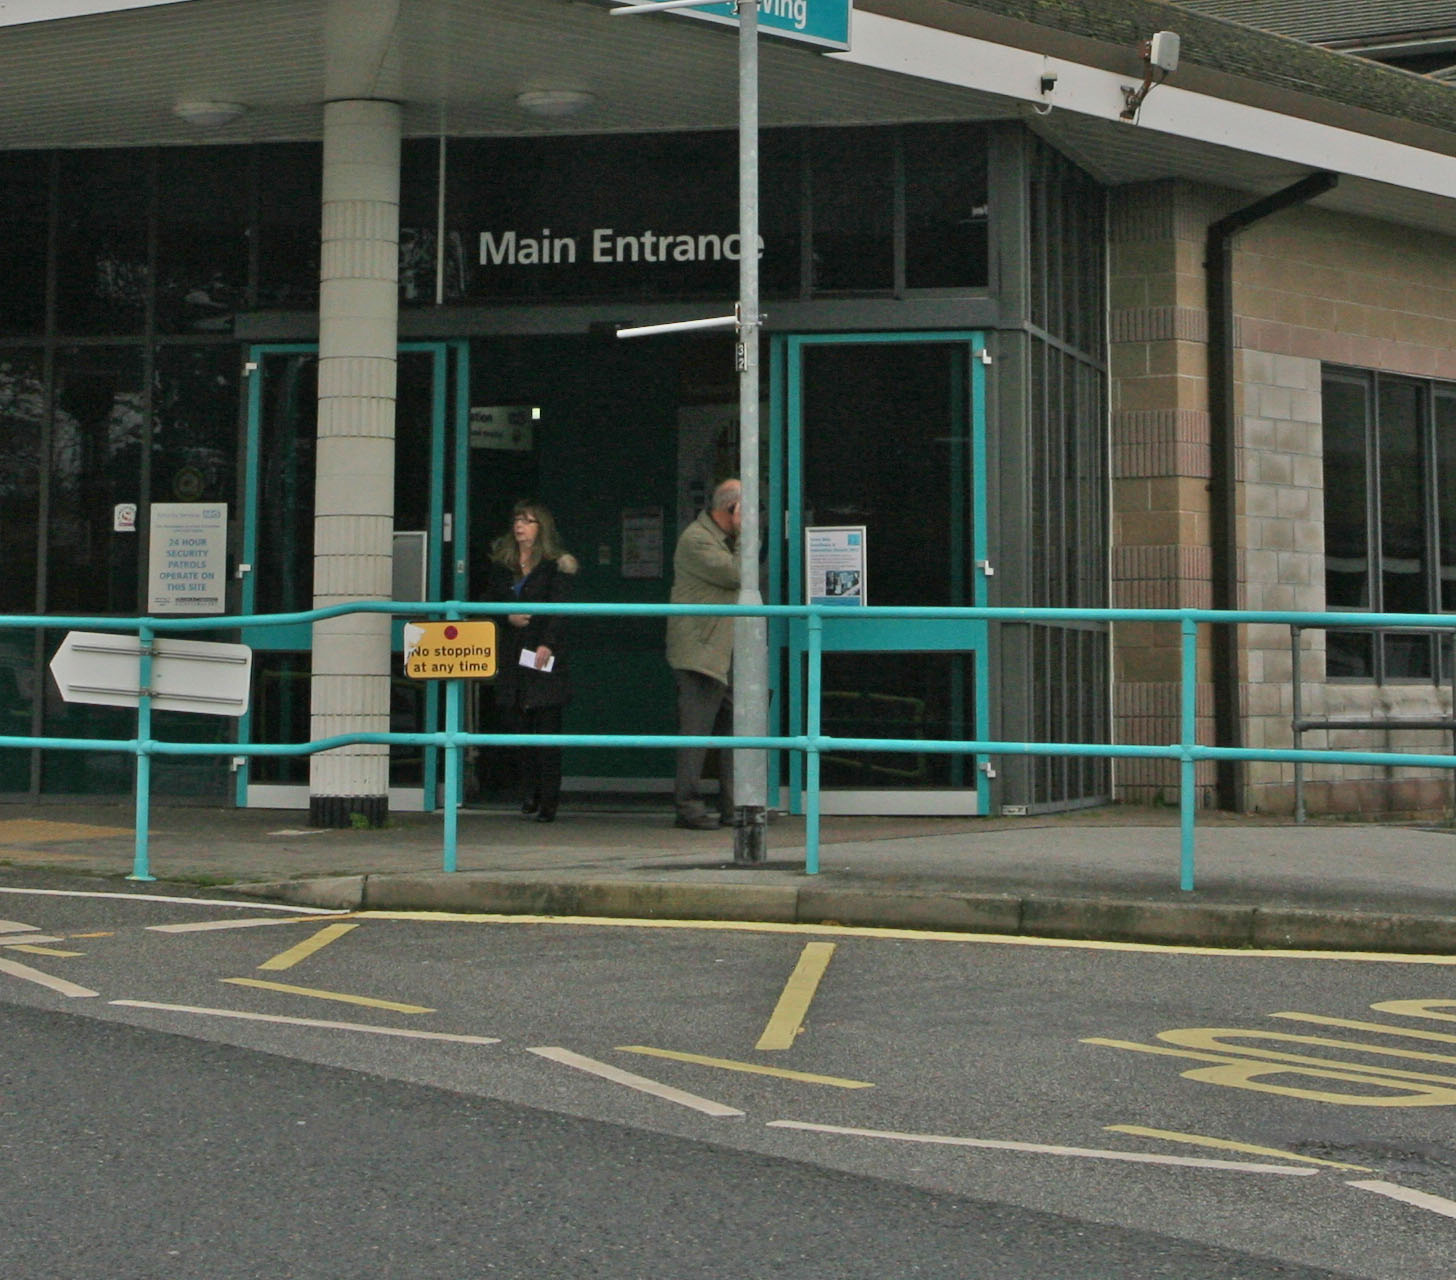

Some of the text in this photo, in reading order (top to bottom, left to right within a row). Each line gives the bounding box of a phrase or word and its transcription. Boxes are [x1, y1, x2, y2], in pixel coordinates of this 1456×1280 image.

[479, 228, 576, 265] Main
[168, 538, 207, 546] 24 HOUR
[166, 549, 209, 558] SECURITY
[168, 560, 207, 569] PATROLS
[159, 572, 215, 580] OPERATE ON
[167, 583, 208, 592] THIS SITE
[409, 645, 491, 658] No stopping
[414, 661, 488, 674] at any time
